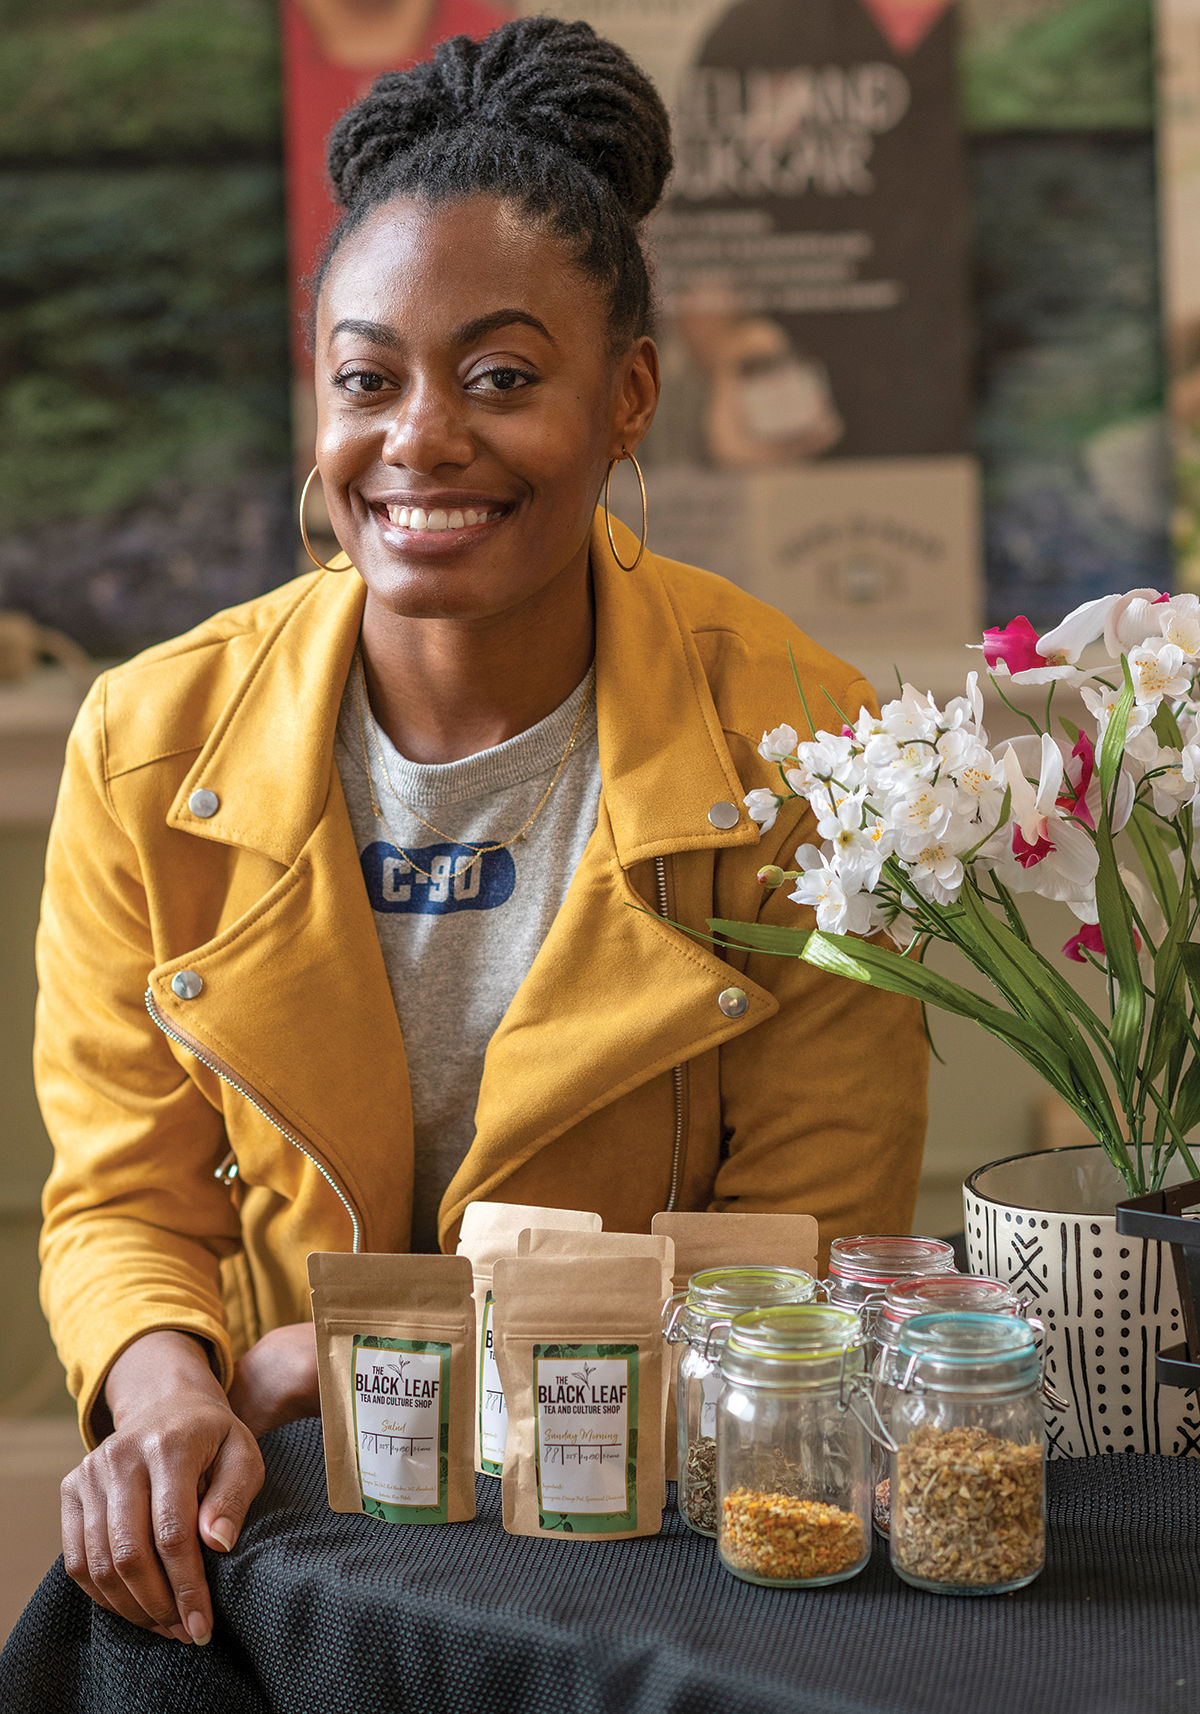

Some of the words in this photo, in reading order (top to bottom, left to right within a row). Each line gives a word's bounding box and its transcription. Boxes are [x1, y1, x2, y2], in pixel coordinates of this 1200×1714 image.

[382, 855, 483, 903] C-90
[372, 1365, 384, 1375] THE
[356, 1373, 399, 1395] BLACK
[404, 1378, 439, 1398] LEAF
[556, 1376, 568, 1385] THE
[360, 1393, 371, 1403] TEA
[372, 1394, 385, 1405] AND
[386, 1396, 413, 1407] CULTURE
[414, 1399, 432, 1408] SHOP
[538, 1385, 585, 1403] BLACK
[592, 1385, 627, 1403] LEAF
[544, 1405, 556, 1414] TEA
[557, 1405, 571, 1414] AND
[573, 1405, 601, 1414] CULTURE
[602, 1405, 621, 1414] SHOP
[544, 1428, 578, 1445] Sunday
[580, 1428, 619, 1443] Morning
